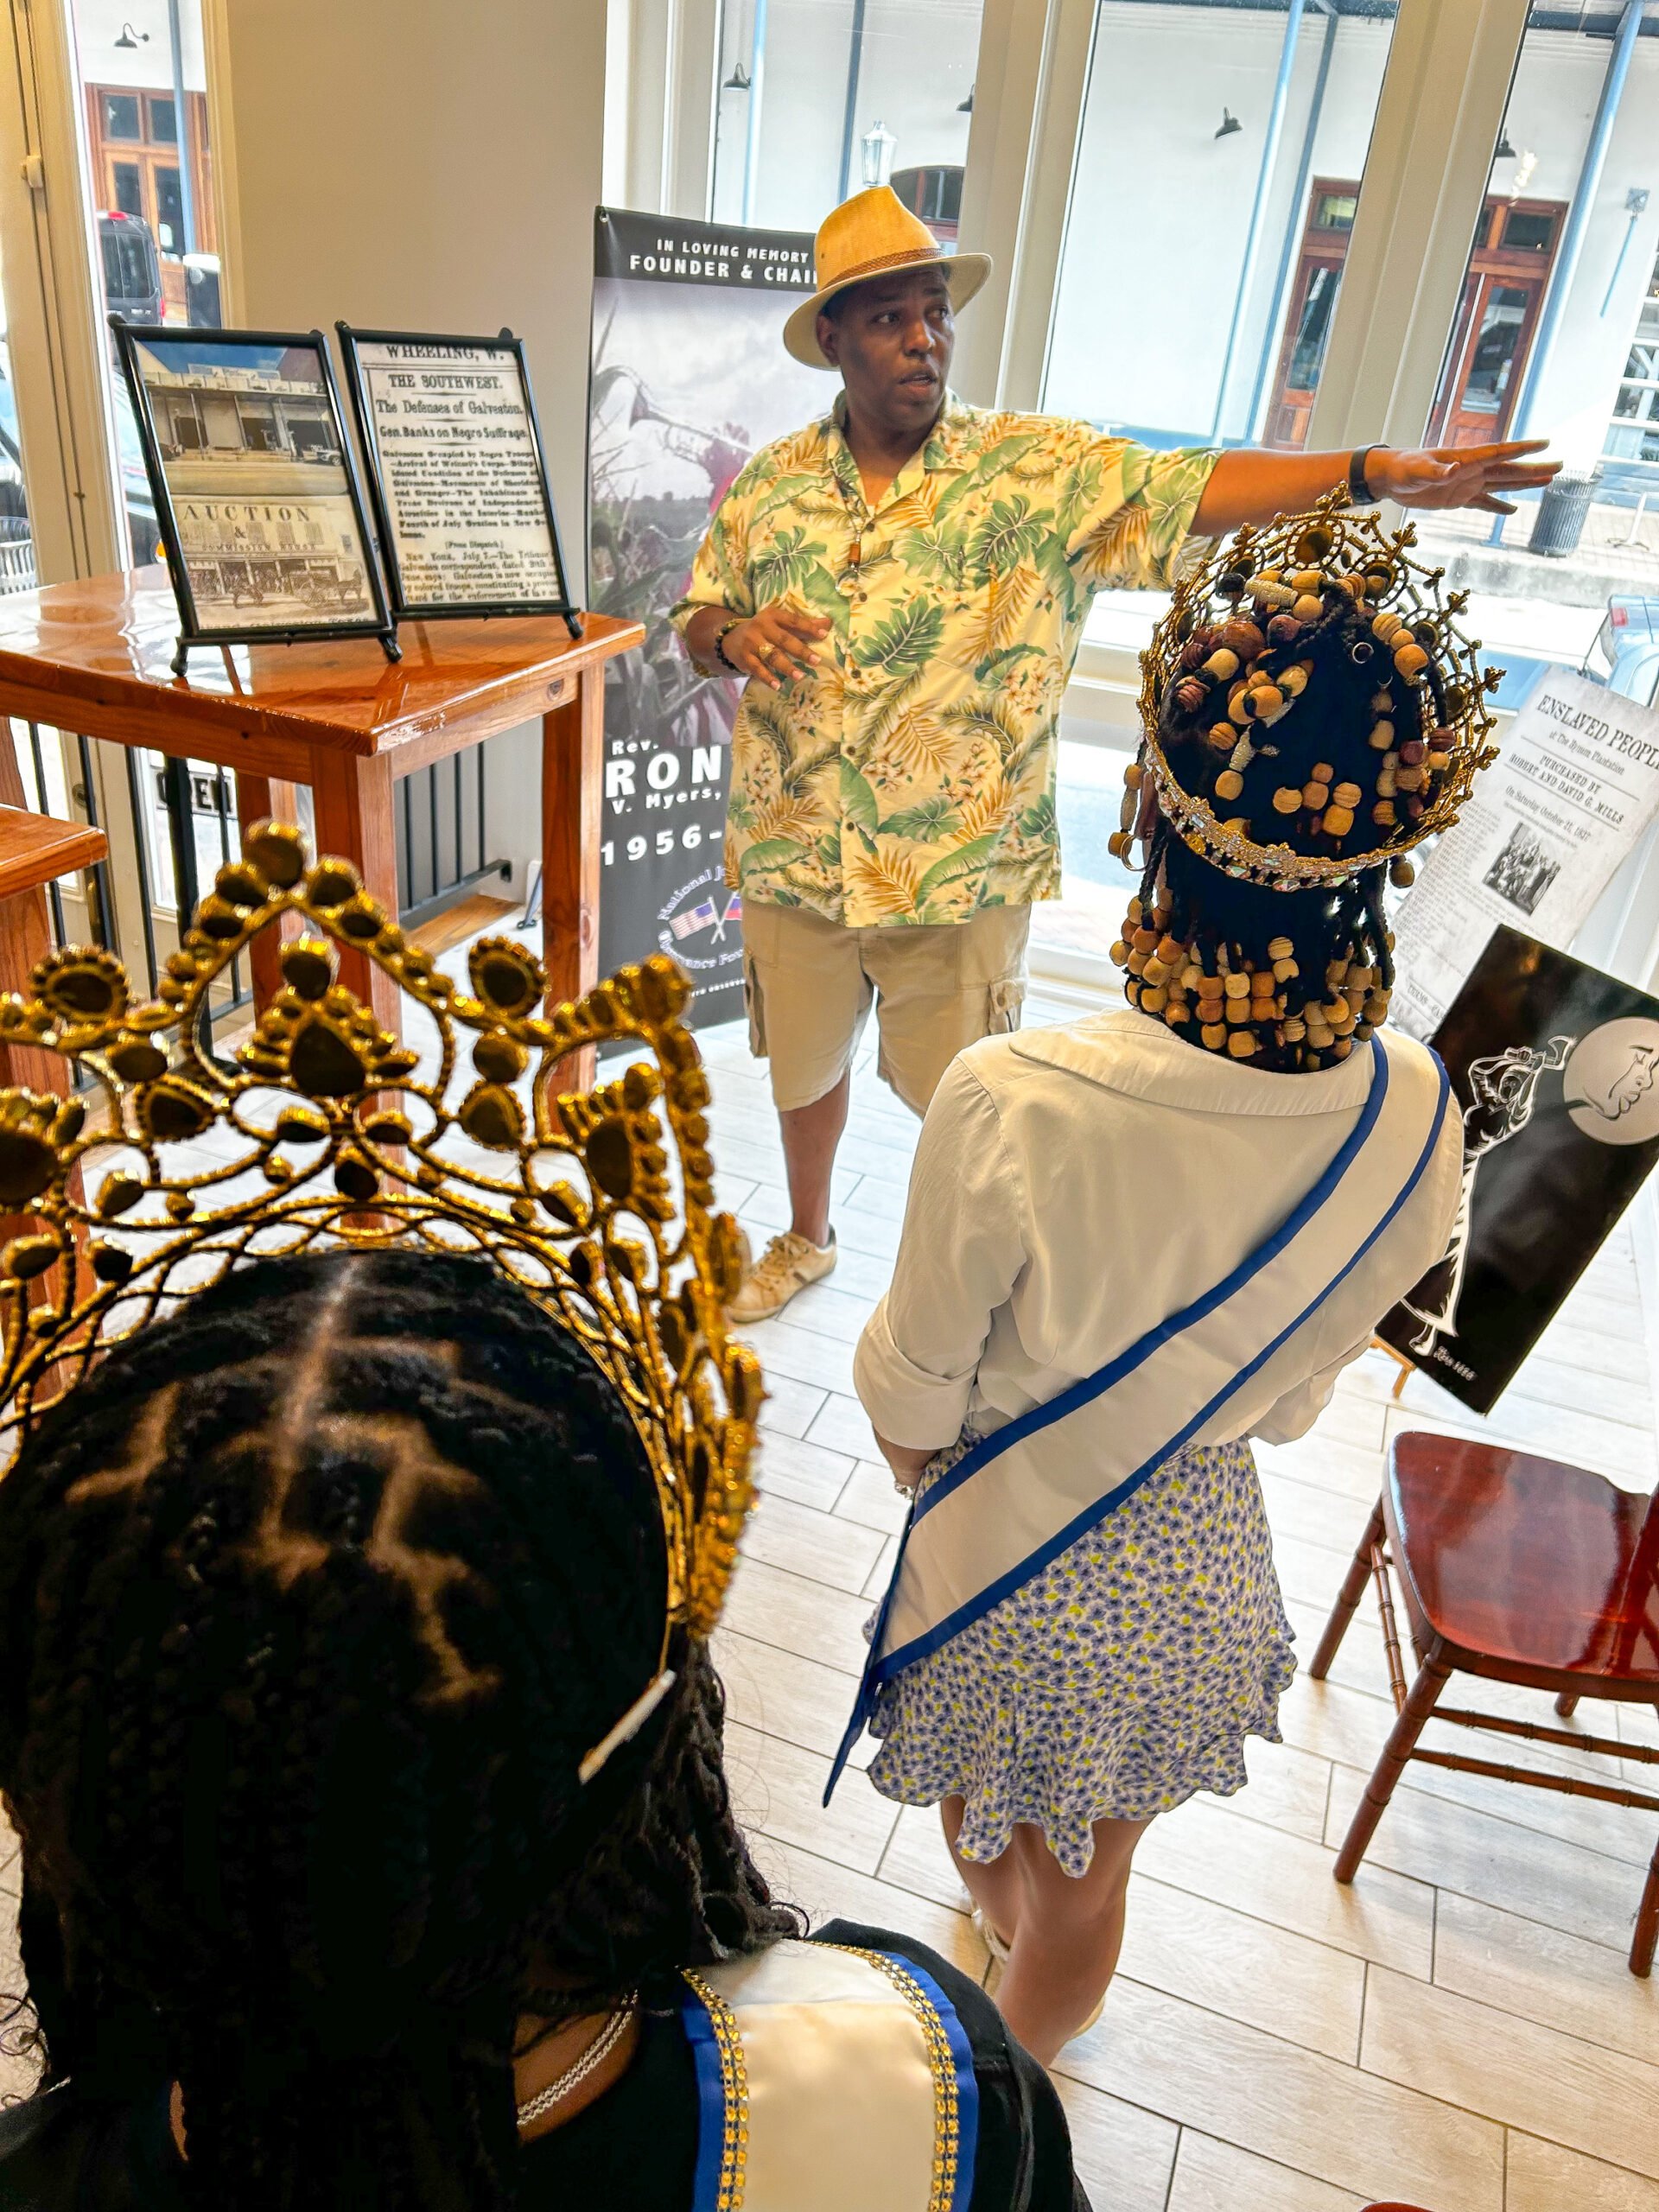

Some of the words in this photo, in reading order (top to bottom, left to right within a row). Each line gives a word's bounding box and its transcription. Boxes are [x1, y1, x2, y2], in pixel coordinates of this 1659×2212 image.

[657, 238, 674, 251] IN
[682, 241, 740, 257] LOVING
[747, 247, 809, 264] MEMORY
[629, 254, 730, 278] FOUNDER
[740, 264, 753, 280] &
[388, 373, 415, 388] THE
[421, 374, 504, 390] SOUTHWEST.
[375, 398, 397, 414] The
[402, 400, 450, 414] Defenses
[454, 400, 464, 414] of
[403, 426, 435, 438] Banks
[436, 429, 450, 438] on
[451, 426, 483, 441] Negro
[183, 504, 310, 522] AUCTION
[234, 524, 247, 539] &
[1535, 694, 1610, 743] ENSLAVED
[1606, 728, 1659, 770] PEOPL
[612, 740, 659, 756] Rev.
[606, 744, 722, 799] RON
[1539, 753, 1588, 788] PURCHASED
[1587, 779, 1602, 796] BY
[612, 798, 632, 815] V.
[645, 787, 722, 810] Myers,
[1509, 753, 1539, 776] ROBERT
[1537, 770, 1558, 787] AND
[1557, 779, 1585, 803] DAVID
[1593, 800, 1624, 824] MILLS
[600, 823, 723, 866] 1956-
[657, 868, 712, 920] National
